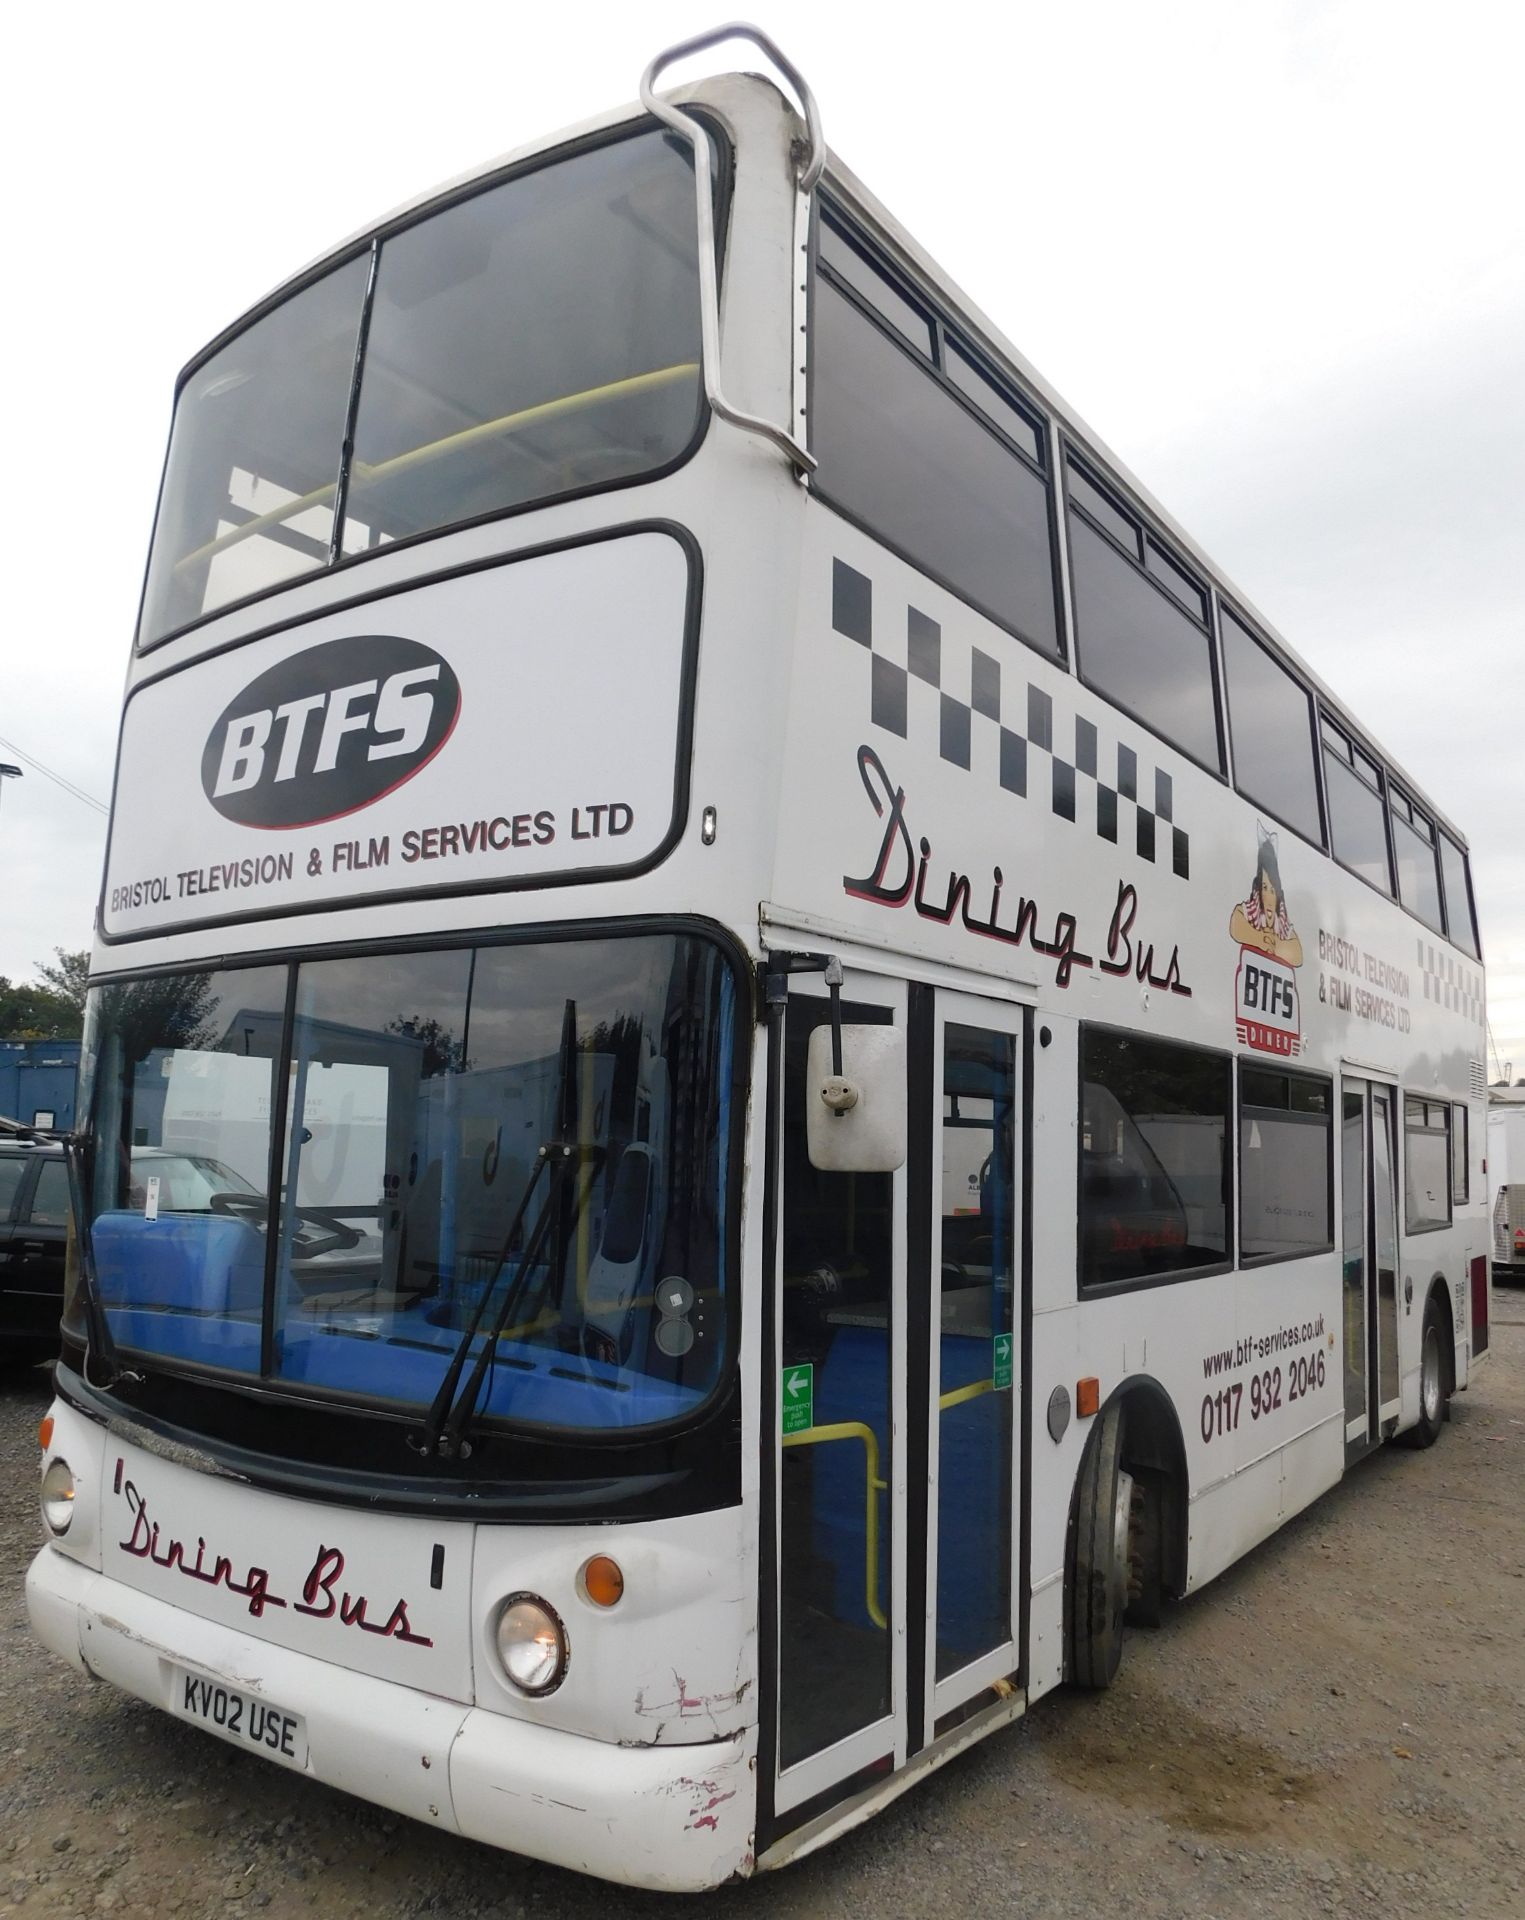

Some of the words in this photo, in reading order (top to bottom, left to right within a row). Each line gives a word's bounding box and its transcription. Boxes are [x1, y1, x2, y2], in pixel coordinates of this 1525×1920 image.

[212, 664, 440, 799] BTFS
[112, 873, 172, 913] BRISTOL
[177, 851, 294, 900] TELEVISION
[307, 846, 323, 876] &
[332, 835, 390, 873] FILM
[401, 809, 556, 863] SERVICES
[570, 802, 635, 842] LTD
[843, 744, 1093, 989] Dining
[1099, 879, 1192, 998] Bus
[1244, 964, 1293, 1019] BTFS
[1319, 928, 1361, 978] BRISTOL
[1362, 952, 1410, 1000] TELEVISION
[1319, 972, 1327, 1004] &
[1330, 975, 1352, 1014] FILM
[1355, 986, 1396, 1030] SERVICES
[1397, 1006, 1411, 1035] LTD
[1250, 1026, 1289, 1051] DINER
[1203, 1313, 1325, 1379] www.btf-services.co.uk
[1201, 1382, 1243, 1445] 0117
[1250, 1366, 1282, 1421] 932
[1288, 1349, 1326, 1402] 2046
[119, 1479, 288, 1617] Dining
[293, 1544, 433, 1648] Bus
[184, 1675, 244, 1734] KV02
[249, 1703, 298, 1758] USE
